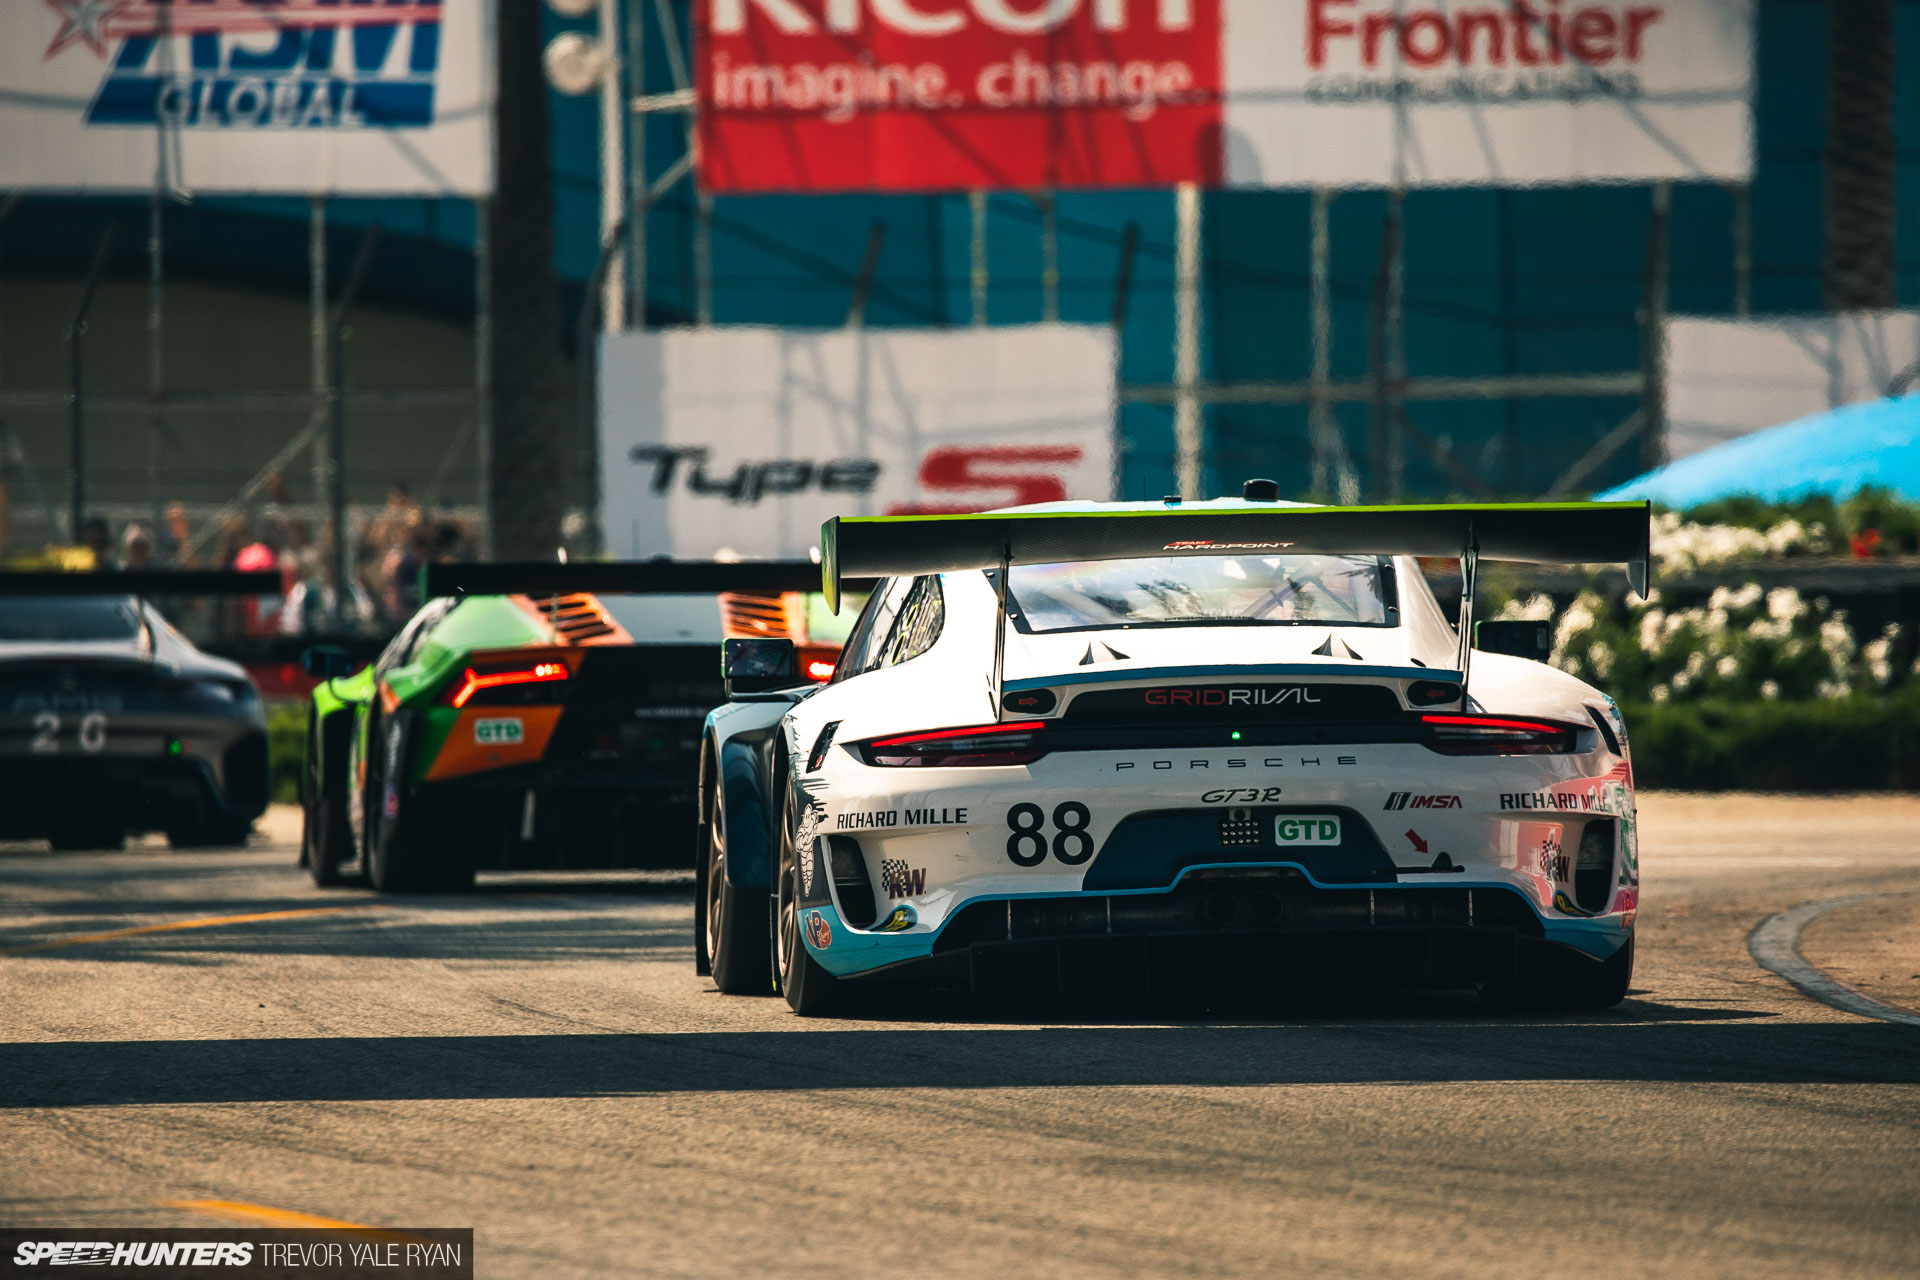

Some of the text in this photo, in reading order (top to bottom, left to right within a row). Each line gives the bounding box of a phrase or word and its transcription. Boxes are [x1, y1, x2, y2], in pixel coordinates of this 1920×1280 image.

[1305, 0, 1660, 69] Frontier
[712, 48, 1192, 123] imagine. change
[157, 77, 365, 129] GLOBAL
[629, 443, 1085, 516] Type S
[1145, 687, 1321, 706] GRIDRIVAL
[32, 711, 106, 753] 20
[476, 720, 522, 741] GTD
[1116, 756, 1357, 771] PORSCHE
[1409, 795, 1463, 809] IMSA
[1500, 792, 1577, 810] RICHARD
[837, 808, 968, 829] RICHARD MILLE
[1006, 801, 1095, 867] 88
[1278, 819, 1338, 841] GTD
